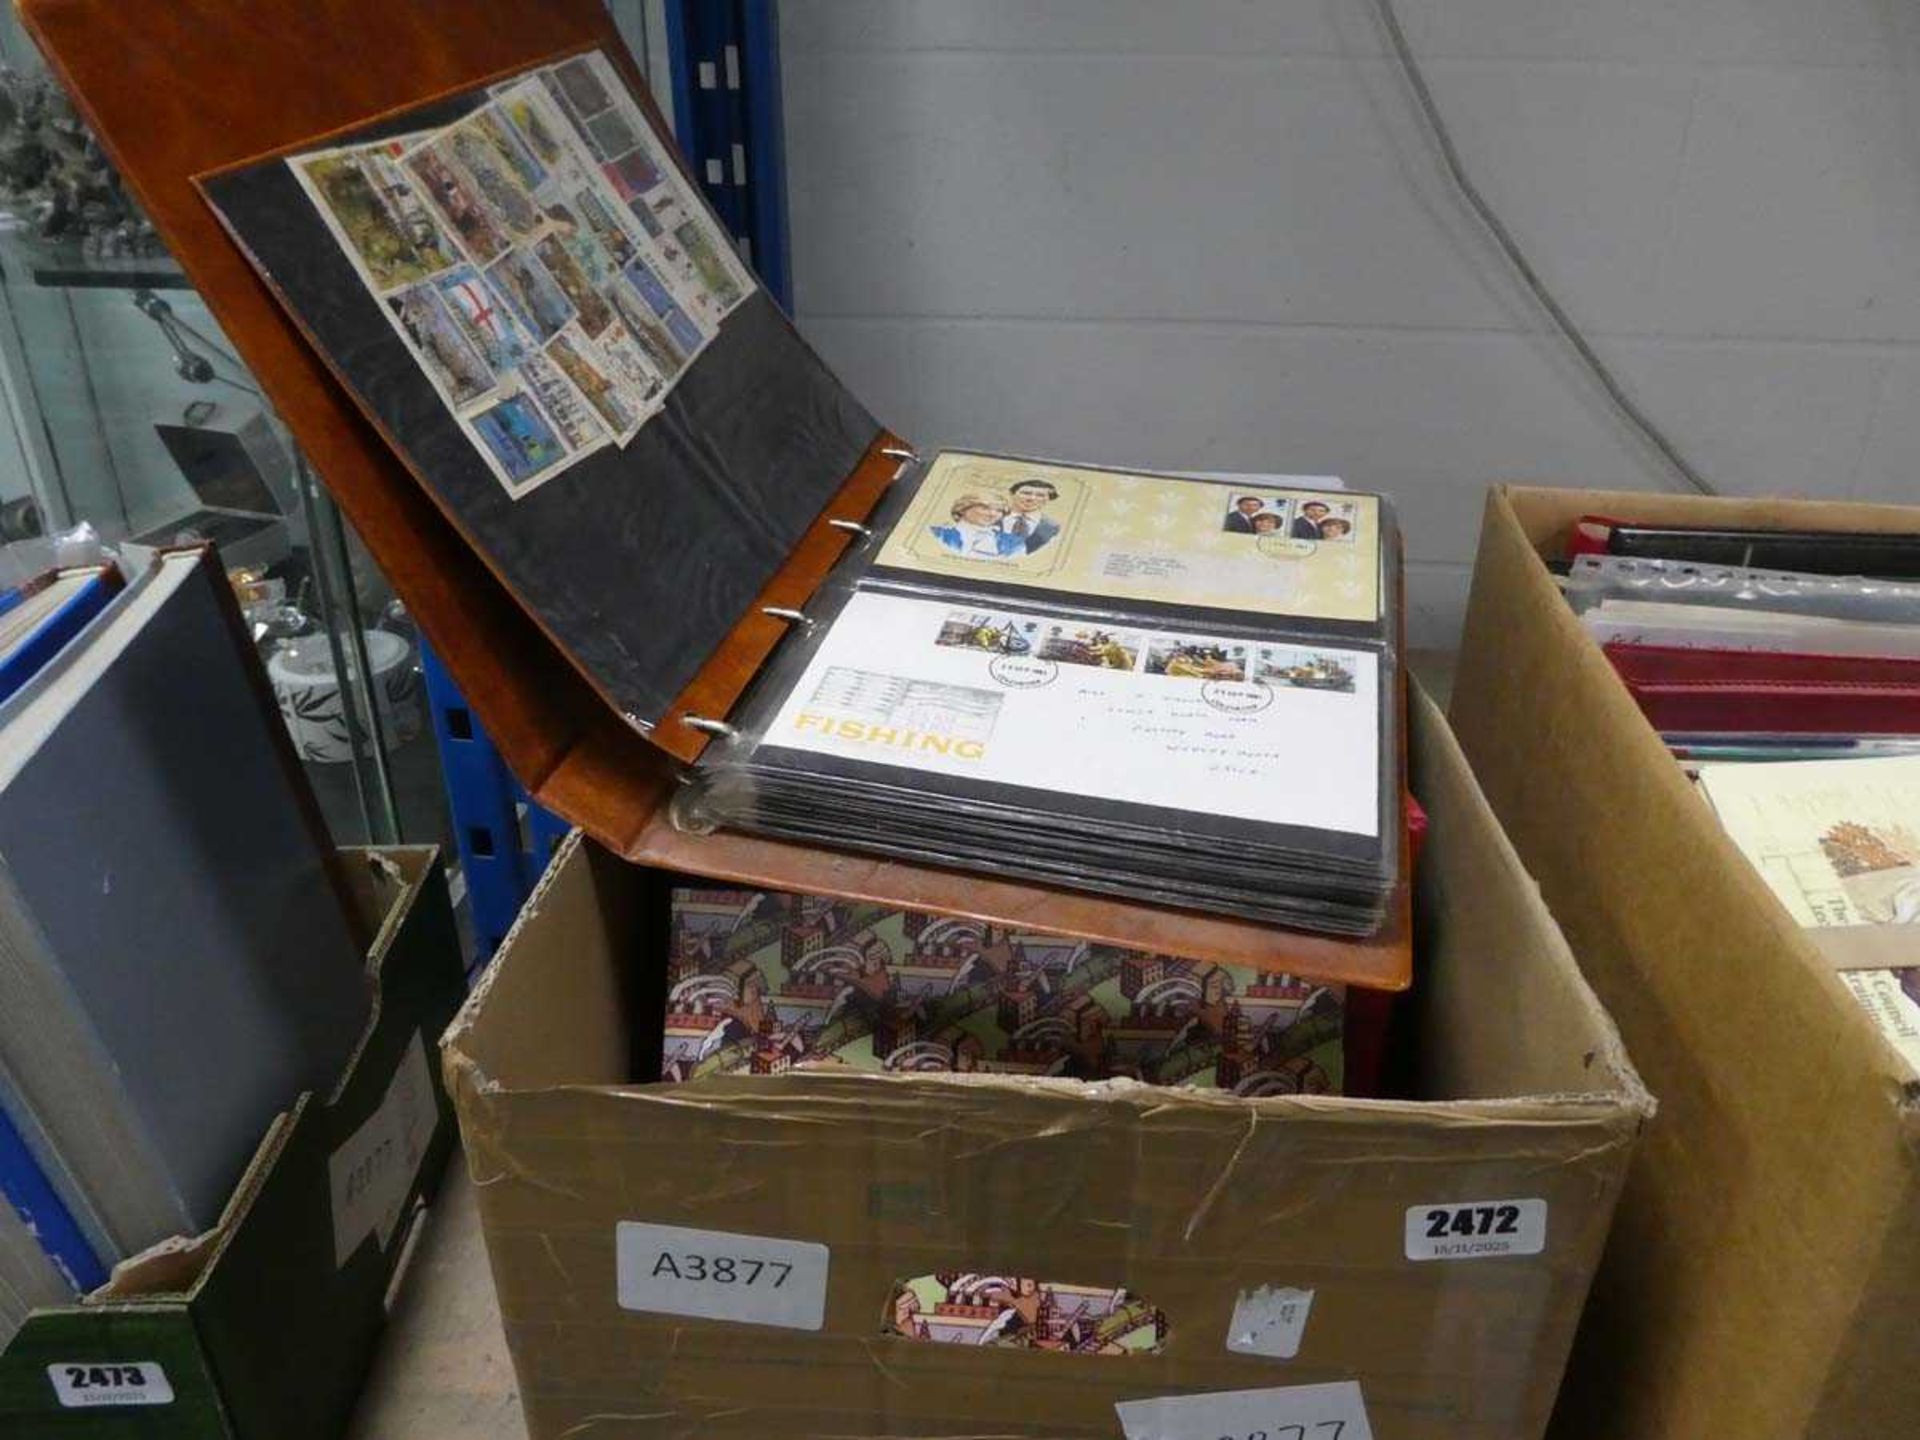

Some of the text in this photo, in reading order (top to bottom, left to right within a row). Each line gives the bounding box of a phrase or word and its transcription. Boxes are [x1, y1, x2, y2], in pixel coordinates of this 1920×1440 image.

[793, 713, 985, 760] FISHING
[1426, 1205, 1520, 1238] 2472
[651, 1251, 793, 1289] A3877
[65, 1366, 146, 1389] 2473
